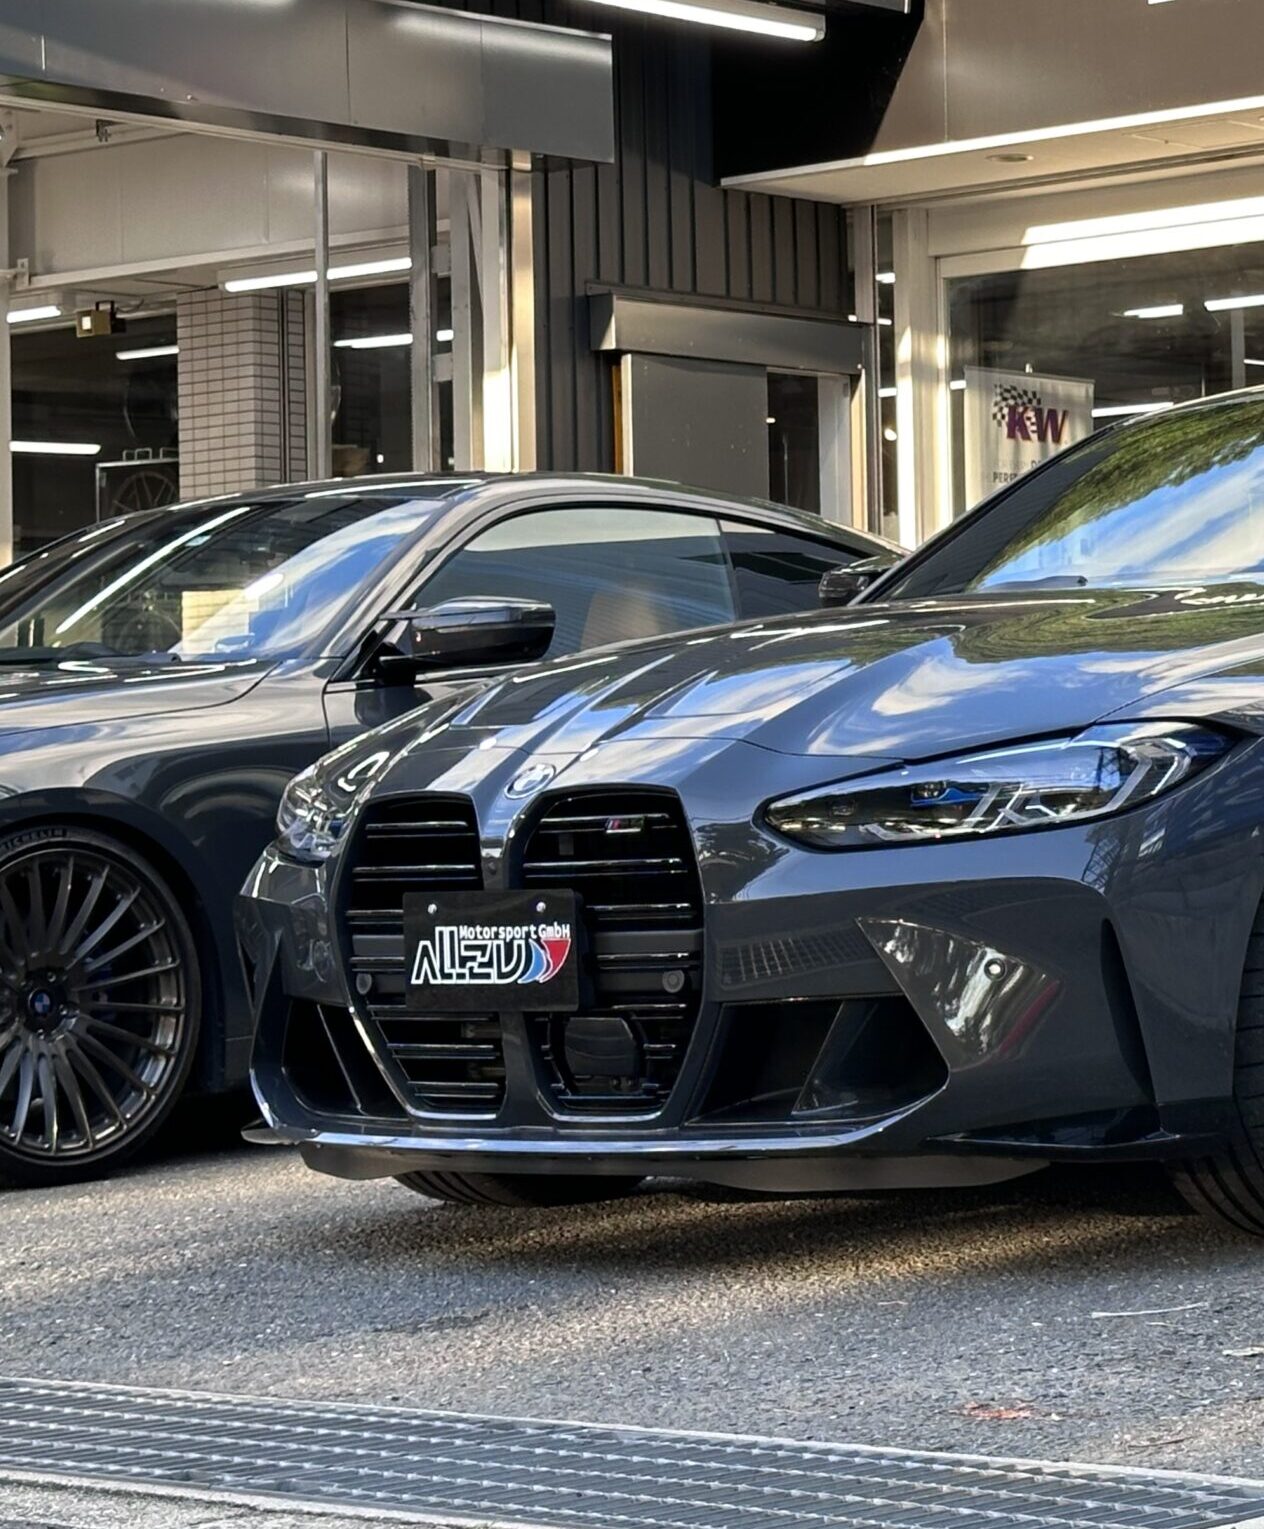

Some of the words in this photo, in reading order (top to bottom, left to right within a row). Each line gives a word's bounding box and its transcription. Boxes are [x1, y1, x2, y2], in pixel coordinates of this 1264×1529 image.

[1006, 404, 1069, 444] KW
[459, 924, 537, 942] Motorsport
[538, 921, 570, 939] GmbH
